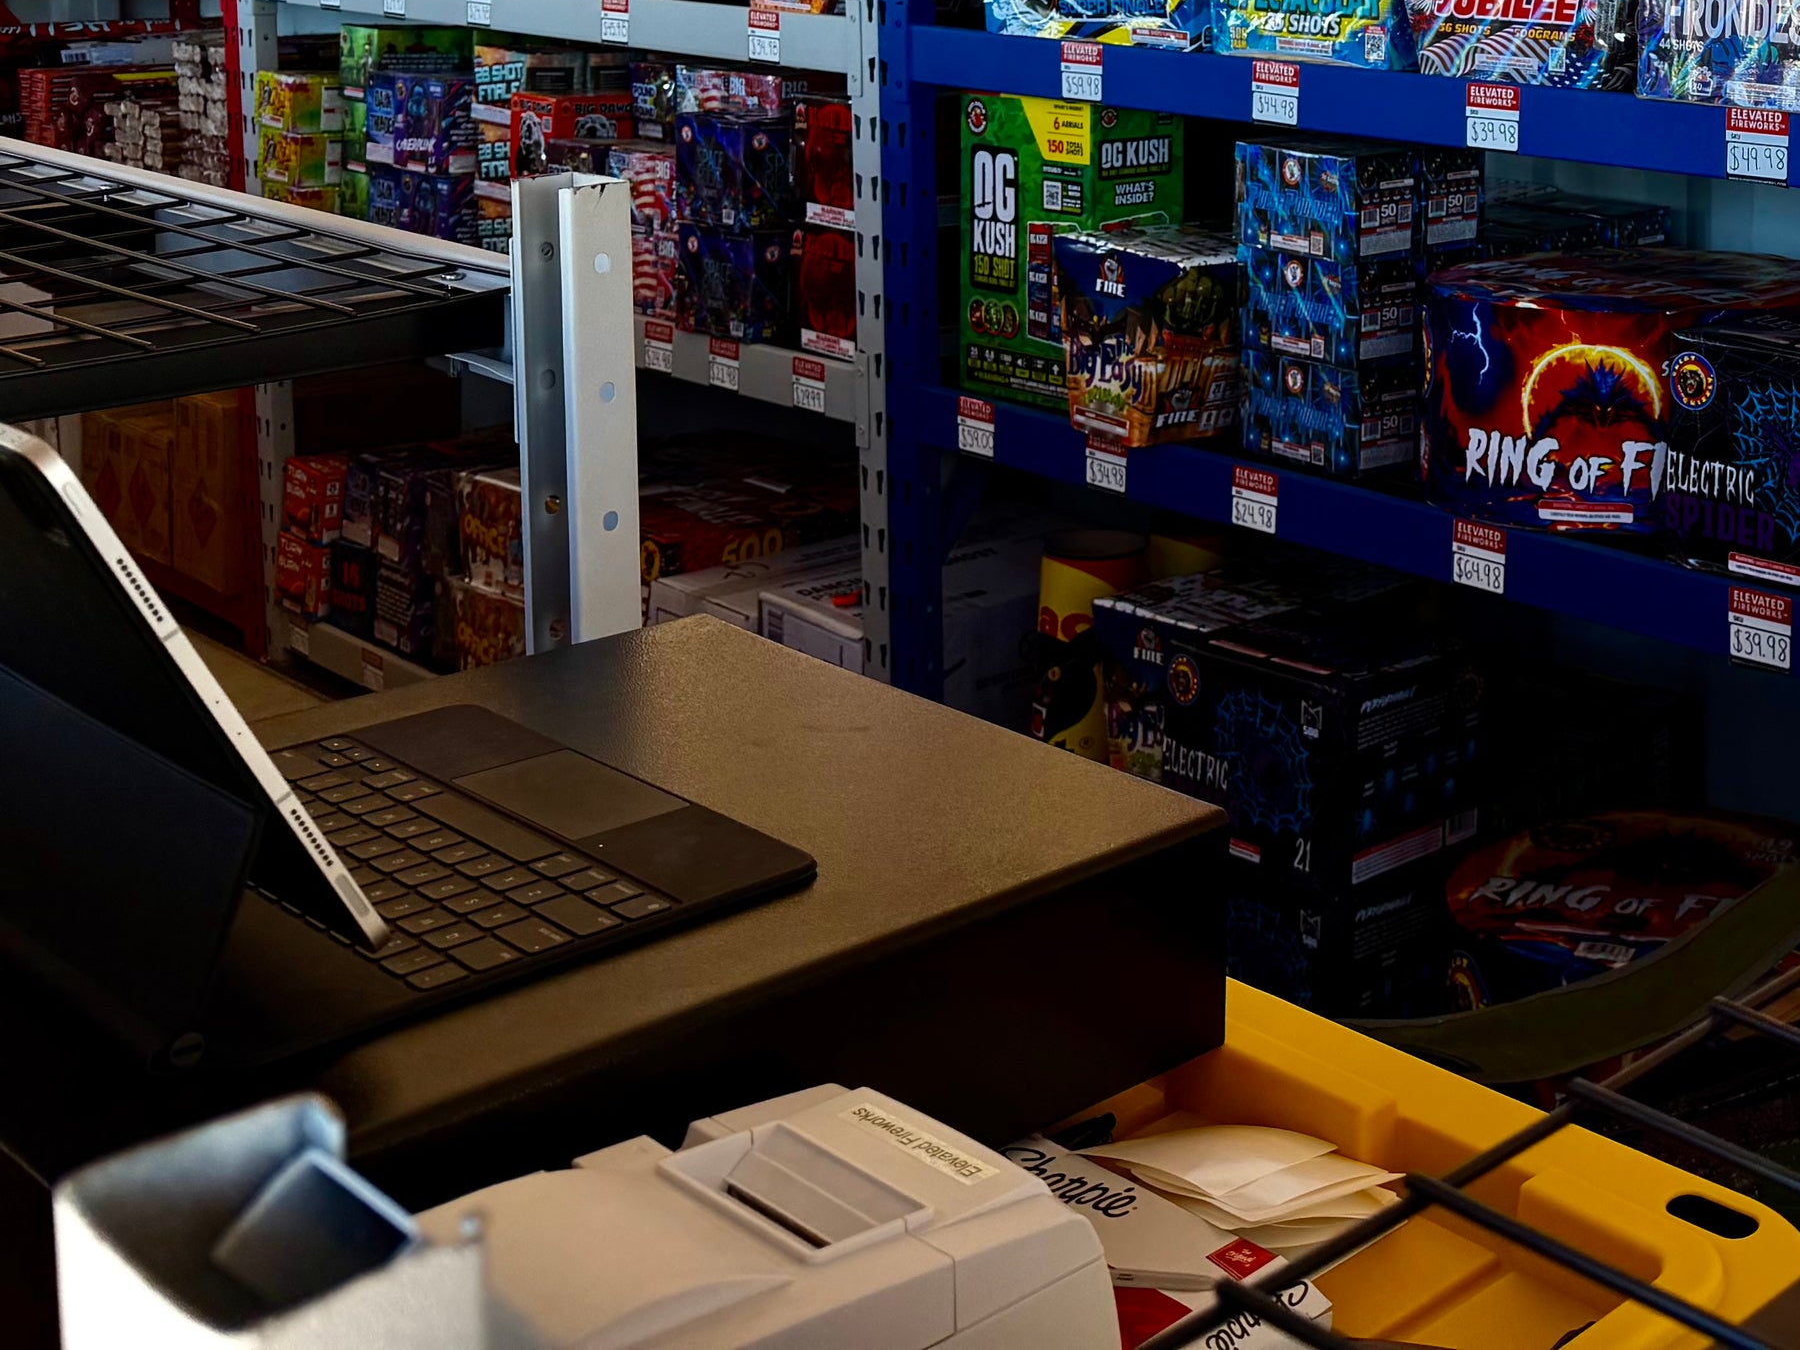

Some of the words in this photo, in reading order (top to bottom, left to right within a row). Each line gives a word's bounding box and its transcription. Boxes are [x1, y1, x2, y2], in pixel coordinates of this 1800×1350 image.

[1255, 63, 1297, 77] ELEVATED
[1469, 87, 1514, 101] ELEVATED
[1729, 144, 1785, 173] $49.98
[973, 150, 1015, 222] OG
[973, 219, 1016, 259] KUSH
[1465, 427, 1559, 492] RING
[1568, 456, 1613, 494] OF
[1666, 450, 1754, 506] ELECTRIC
[1664, 492, 1776, 552] SPIDER
[1731, 625, 1791, 664] $39.98
[1469, 876, 1600, 913] RING
[851, 1106, 922, 1151] Fireworks
[910, 1137, 982, 1179] Elevated
